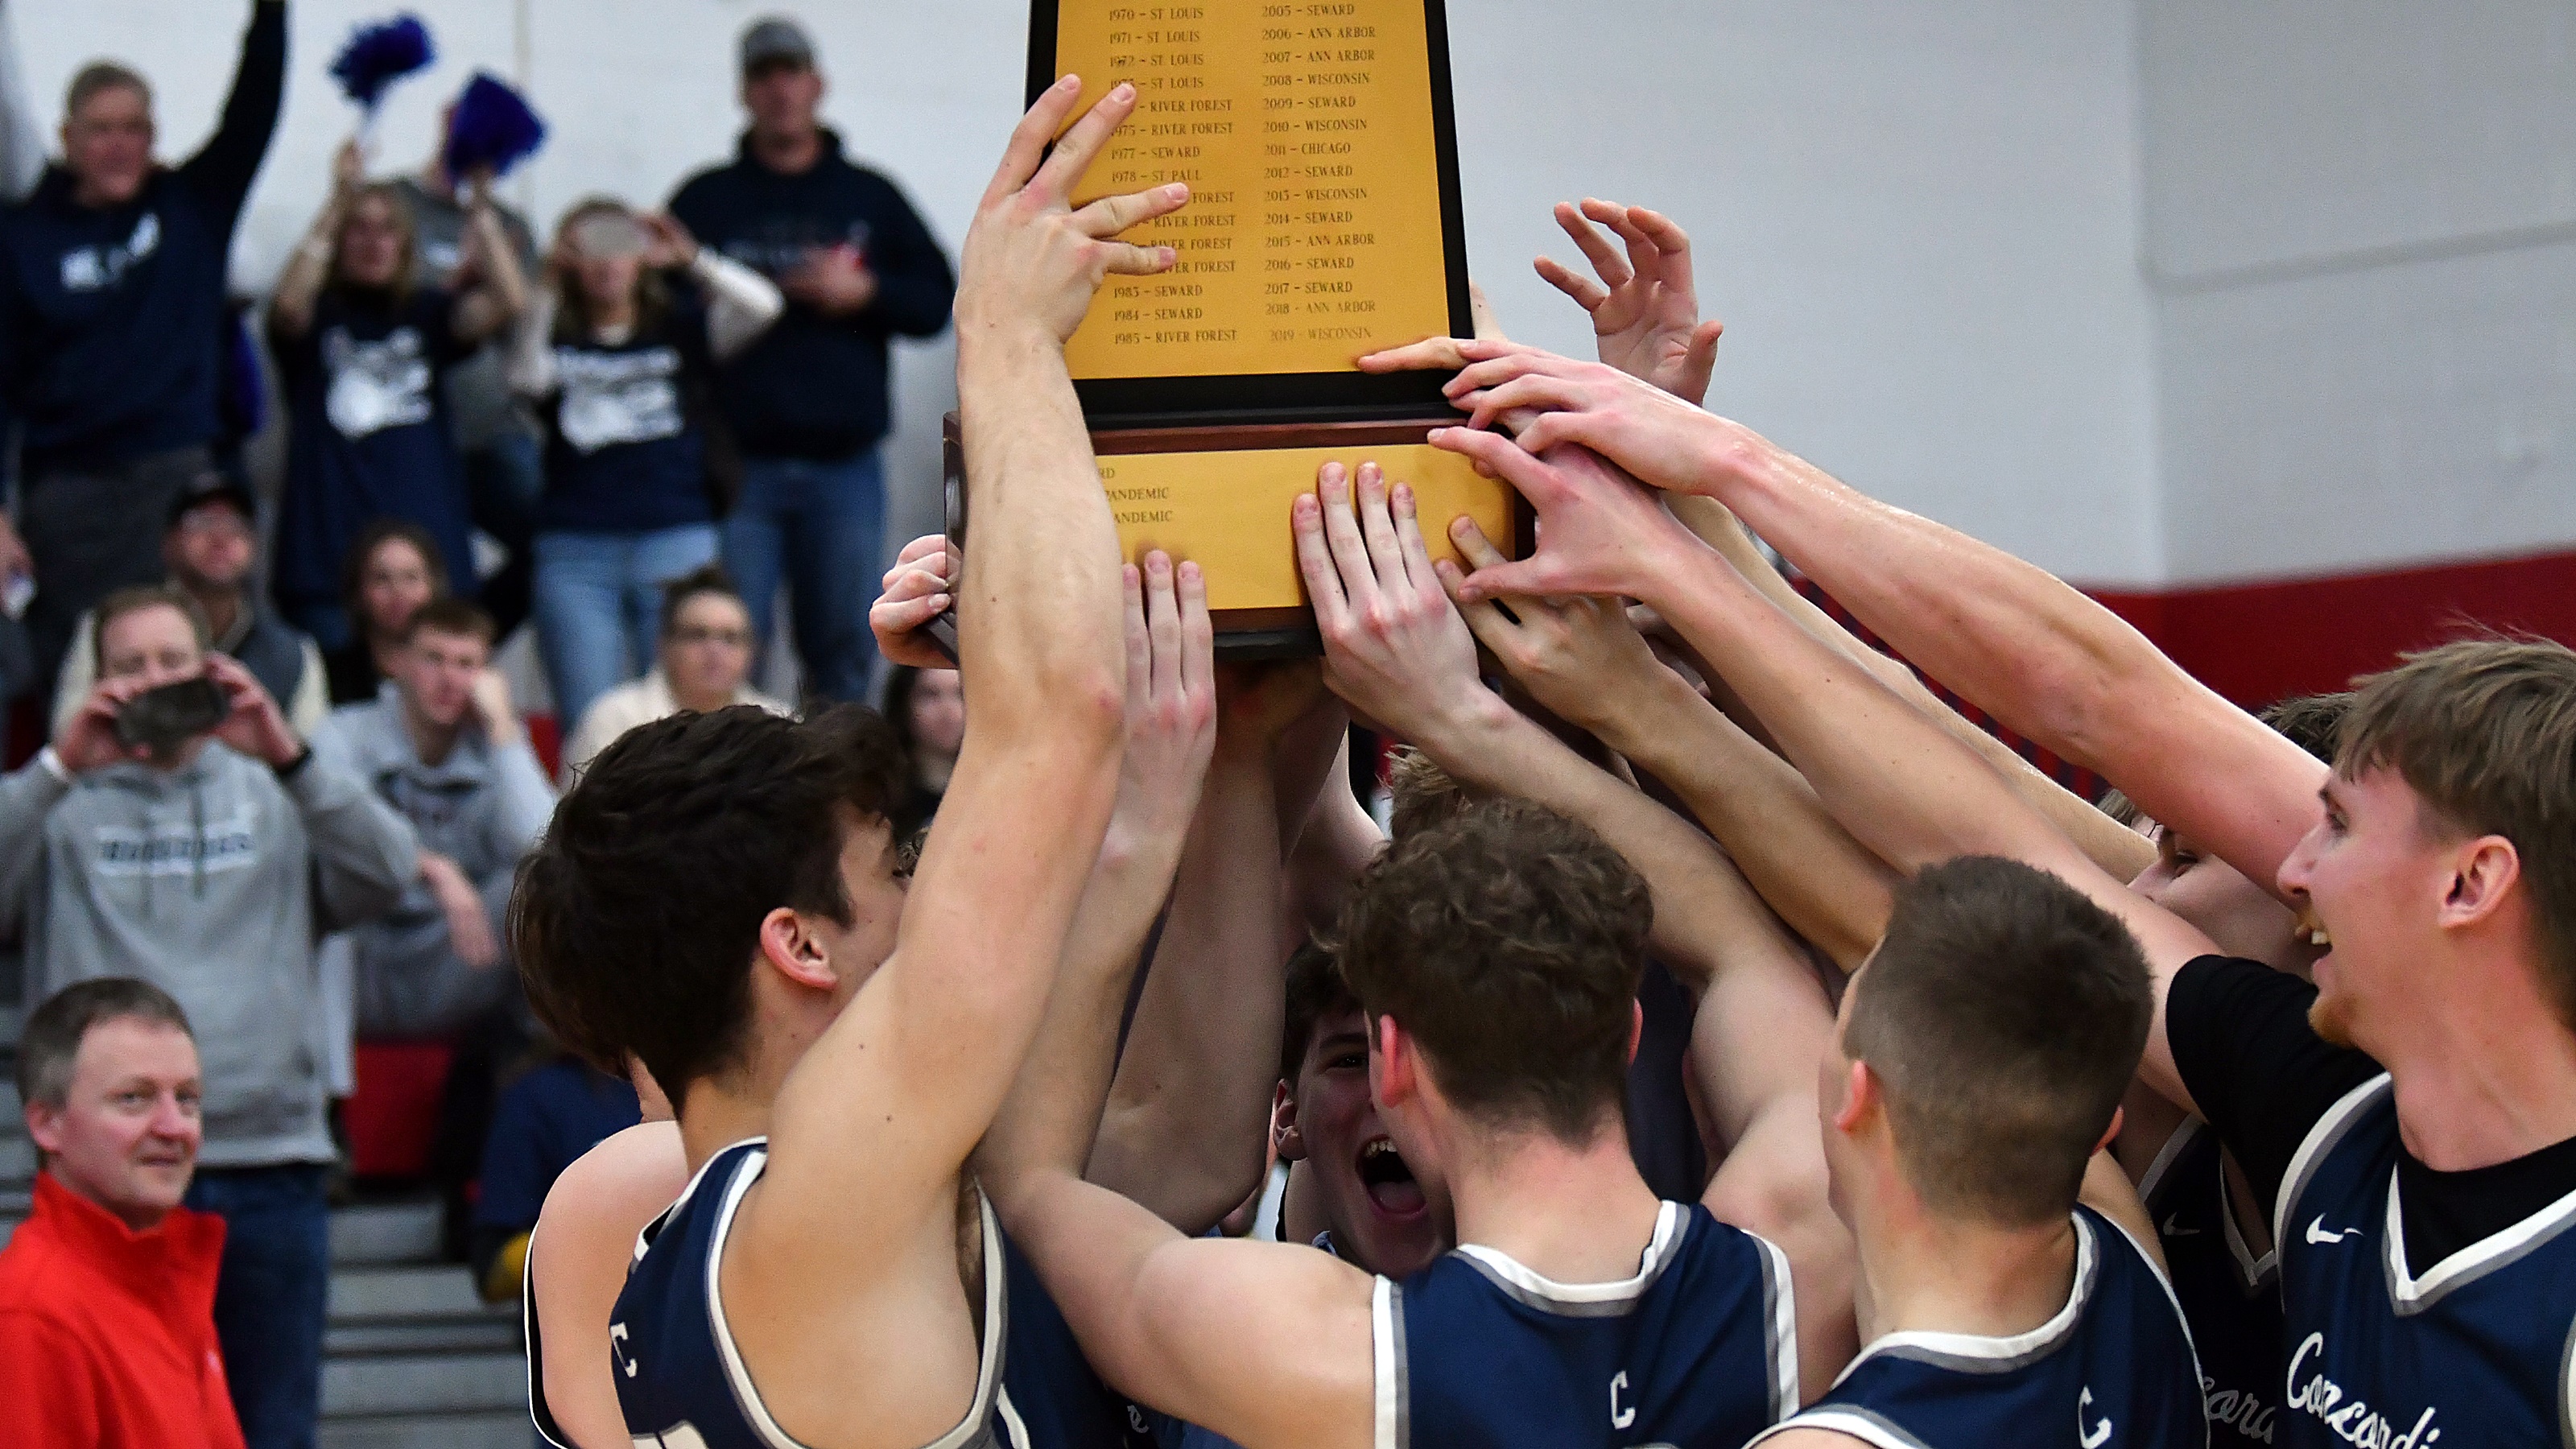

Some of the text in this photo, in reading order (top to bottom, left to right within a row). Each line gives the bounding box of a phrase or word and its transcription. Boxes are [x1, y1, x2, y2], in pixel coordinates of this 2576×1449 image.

[1150, 9, 1164, 19] ST
[1170, 8, 1203, 19] LOUIS
[1307, 4, 1355, 16] SEWARD
[1109, 32, 1131, 44] 1971
[1147, 32, 1160, 43] ST
[1167, 31, 1199, 43] LOUIS
[1262, 28, 1291, 40] 2006
[1308, 27, 1331, 39] ANN
[1337, 27, 1376, 38] ARBOR
[1150, 55, 1163, 66] ST
[1170, 53, 1203, 66] LOUIS
[1262, 52, 1290, 64] 2007
[1307, 51, 1331, 62] ANN
[1337, 50, 1375, 61] ARBOR
[1150, 78, 1164, 89] ST
[1170, 77, 1203, 89] LOUIS
[1262, 75, 1291, 87] 2008
[1307, 72, 1370, 85] WISCONSIN
[1150, 100, 1186, 113] RIVER
[1191, 99, 1232, 112] FOREST
[1262, 97, 1292, 109] 2009
[1308, 96, 1356, 108] SEWARD
[1112, 124, 1136, 137] 975
[1151, 123, 1187, 135] RIVER
[1191, 122, 1232, 134] FOREST
[1262, 121, 1289, 133] 2010
[1305, 118, 1367, 131] WISCONSIN
[1111, 147, 1135, 159] 1977
[1151, 146, 1200, 159] SEWARD
[1264, 144, 1286, 155] 2011
[1302, 142, 1351, 155] CHICAGO
[1112, 171, 1136, 182] 1978
[1152, 170, 1165, 182] ST
[1171, 169, 1202, 181] PAUL
[1264, 167, 1290, 179] 2012
[1306, 165, 1352, 178] SEWARD
[1192, 192, 1235, 204] FOREST
[1306, 188, 1367, 200] WISCONSIN
[1154, 215, 1236, 228] RIVER FOREST
[1306, 211, 1352, 224] SEWARD
[1191, 237, 1232, 250] FOREST
[1307, 236, 1331, 246] ANN
[1335, 233, 1375, 246] ARBOR
[1194, 261, 1236, 273] FOREST
[1264, 259, 1291, 271] 2016
[1307, 257, 1354, 270] SEWARD
[1154, 285, 1203, 297] SEWARD
[1265, 283, 1290, 295] 2017
[1305, 281, 1352, 294] SEWARD
[1154, 308, 1203, 320] SEWARD
[1265, 303, 1290, 316] 2018
[1307, 302, 1330, 314] ANN
[1338, 300, 1376, 313] ARBOR
[1155, 332, 1190, 344] RIVER
[1195, 329, 1237, 342] FOREST
[1307, 327, 1372, 341] WISCONSIN
[1114, 510, 1173, 524] ANDEMIC
[610, 1321, 638, 1378] C
[1610, 1370, 1636, 1430] C
[2078, 1385, 2112, 1449] C
